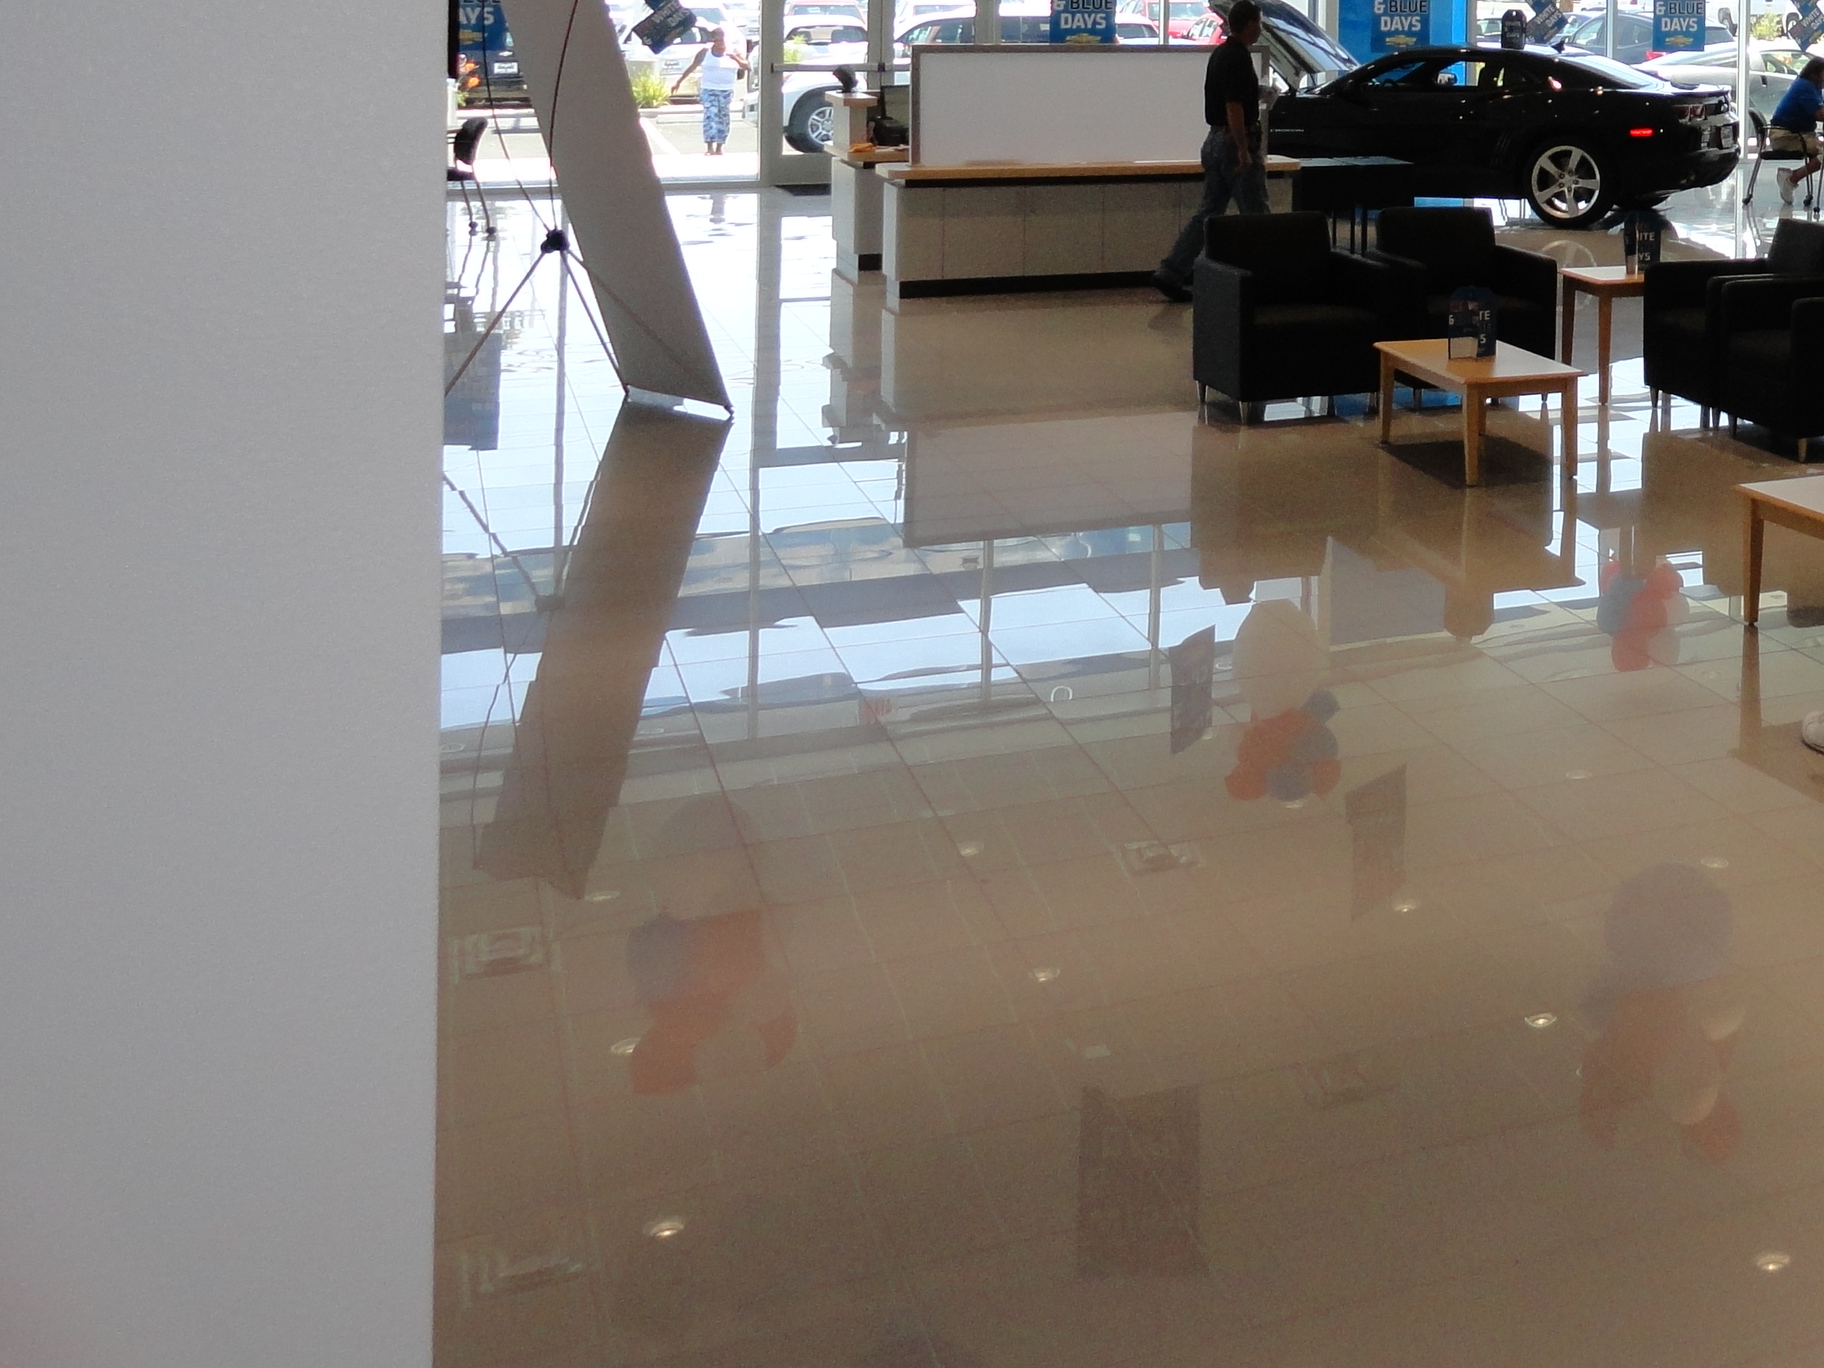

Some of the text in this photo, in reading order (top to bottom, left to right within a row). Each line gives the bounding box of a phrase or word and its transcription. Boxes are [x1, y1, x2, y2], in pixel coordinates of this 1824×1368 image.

[1374, 0, 1428, 14] & BLUE
[1656, 1, 1704, 15] & BLUE
[459, 7, 494, 25] AYS
[1060, 13, 1106, 29] DAYS
[1381, 16, 1421, 31] DAYS
[1661, 18, 1697, 31] DAYS
